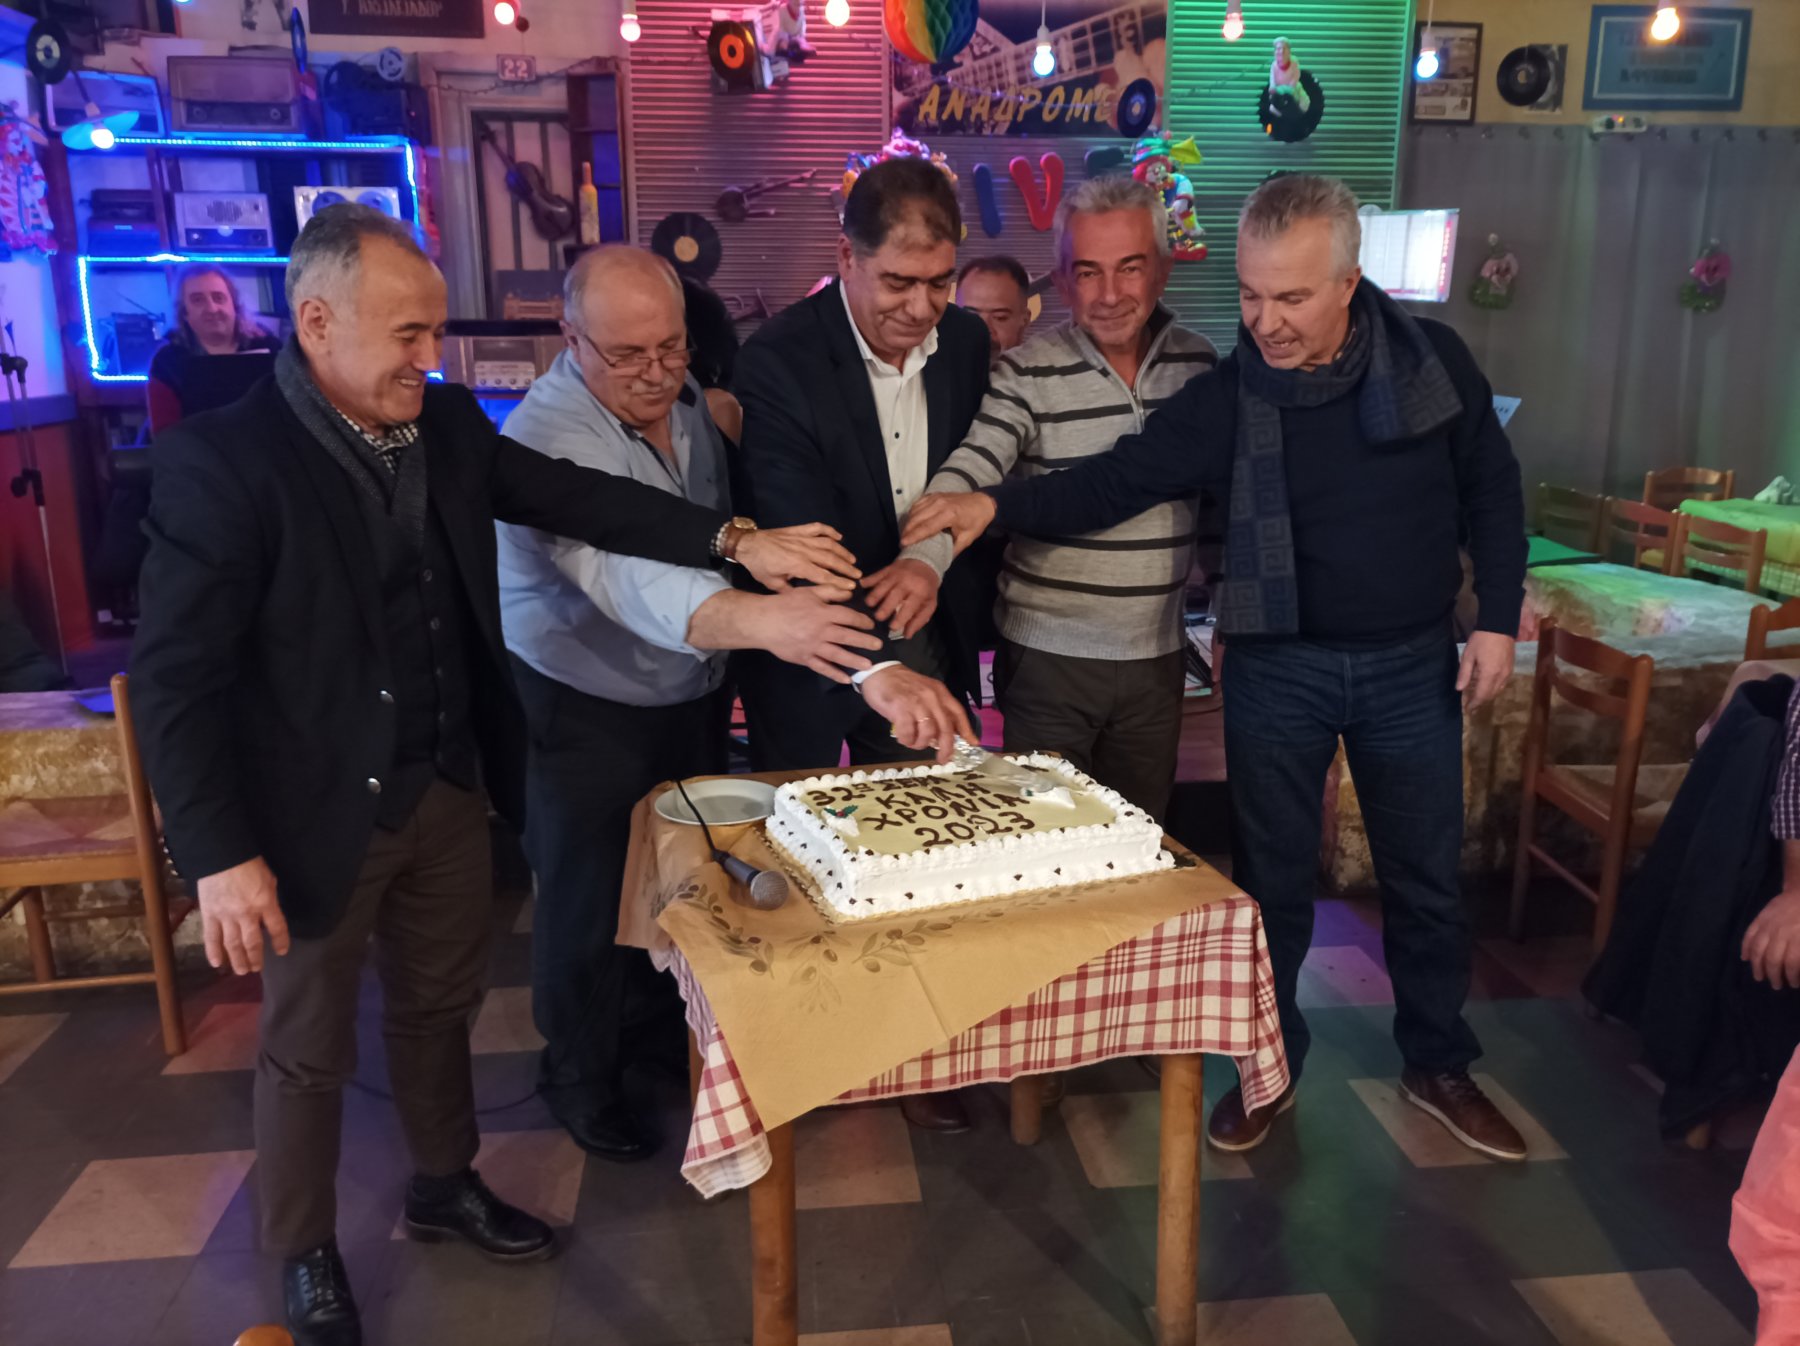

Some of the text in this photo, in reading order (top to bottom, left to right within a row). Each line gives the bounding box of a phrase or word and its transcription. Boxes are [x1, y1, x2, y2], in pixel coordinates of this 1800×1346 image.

[504, 57, 529, 75] 22
[875, 782, 991, 809] ΚΑΛΗ
[863, 793, 1030, 830] ΧΡΟΝΙΑ
[914, 811, 1036, 847] 2023
